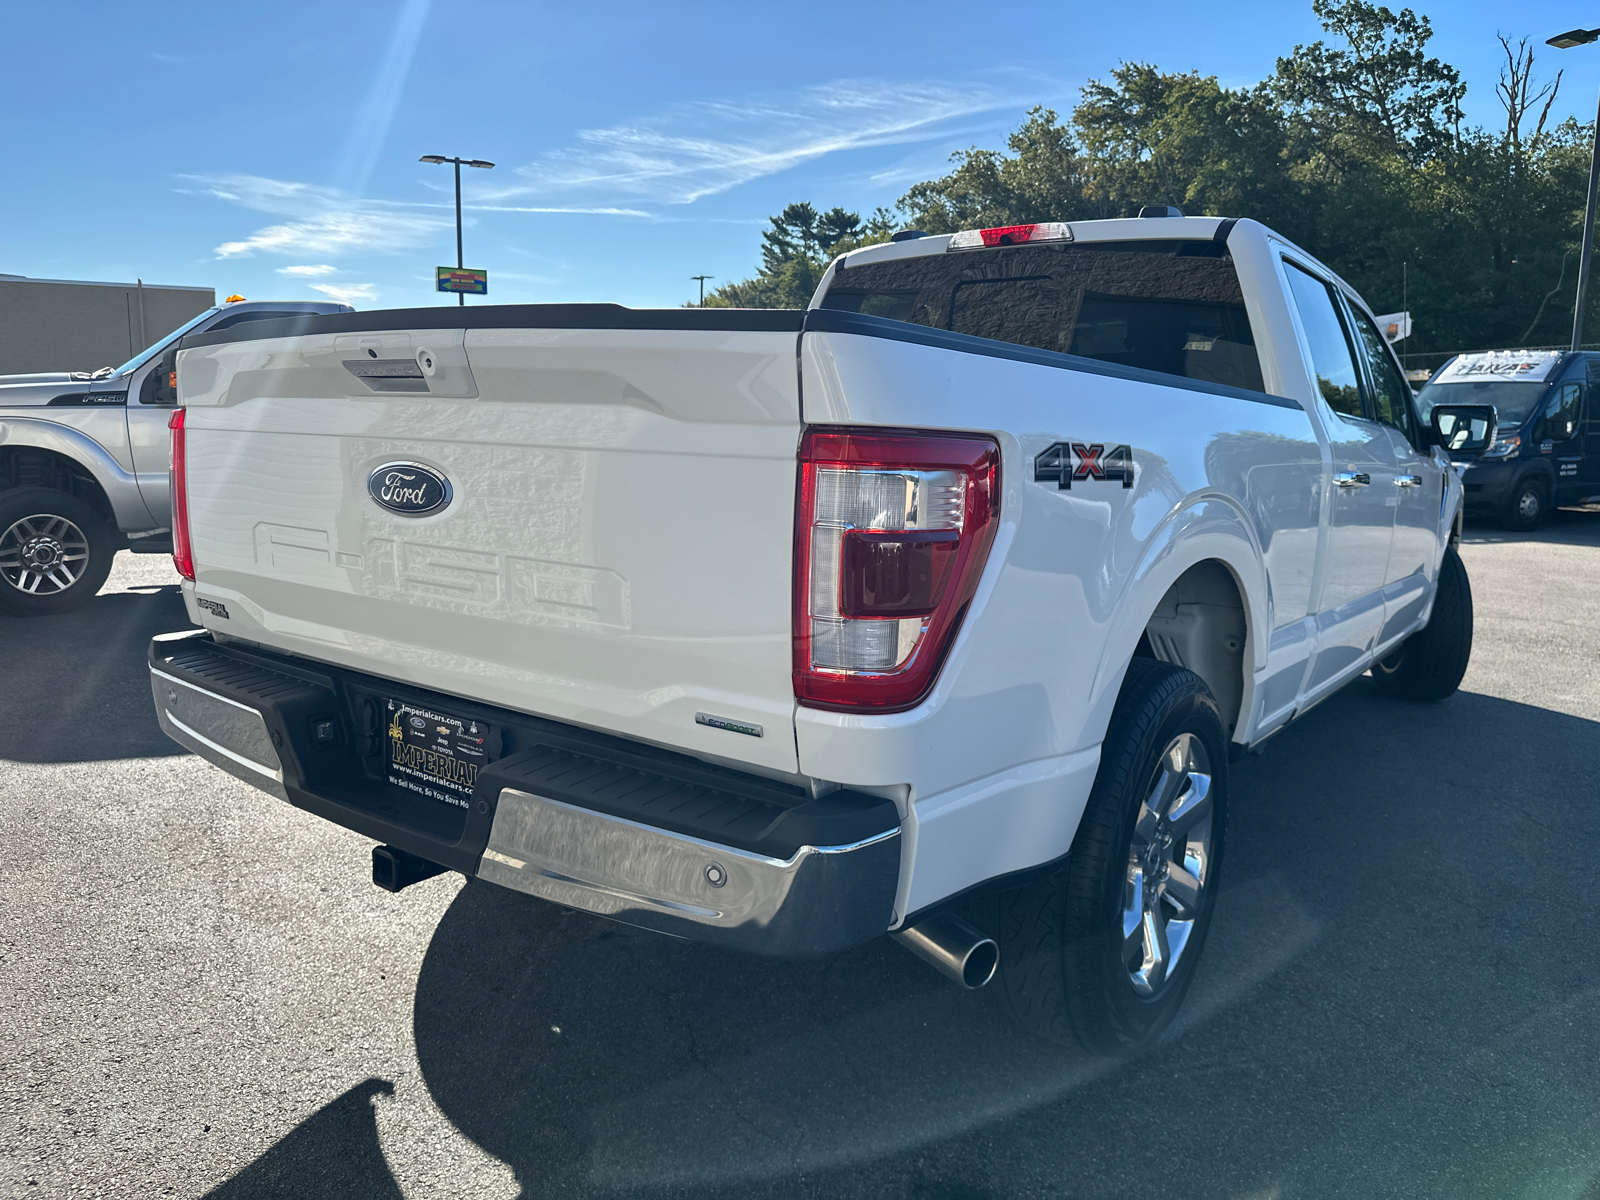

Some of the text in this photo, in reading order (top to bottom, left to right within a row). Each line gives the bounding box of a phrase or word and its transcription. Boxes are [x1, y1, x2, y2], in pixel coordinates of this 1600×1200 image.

[381, 471, 427, 506] Ford
[401, 704, 462, 728] Imperialcars.com
[437, 746, 454, 756] TOYOTA
[389, 775, 398, 785] We
[398, 779, 409, 789] Sell
[424, 788, 433, 797] So
[433, 790, 444, 801] You
[445, 794, 459, 806] Save
[460, 799, 470, 809] Mo
